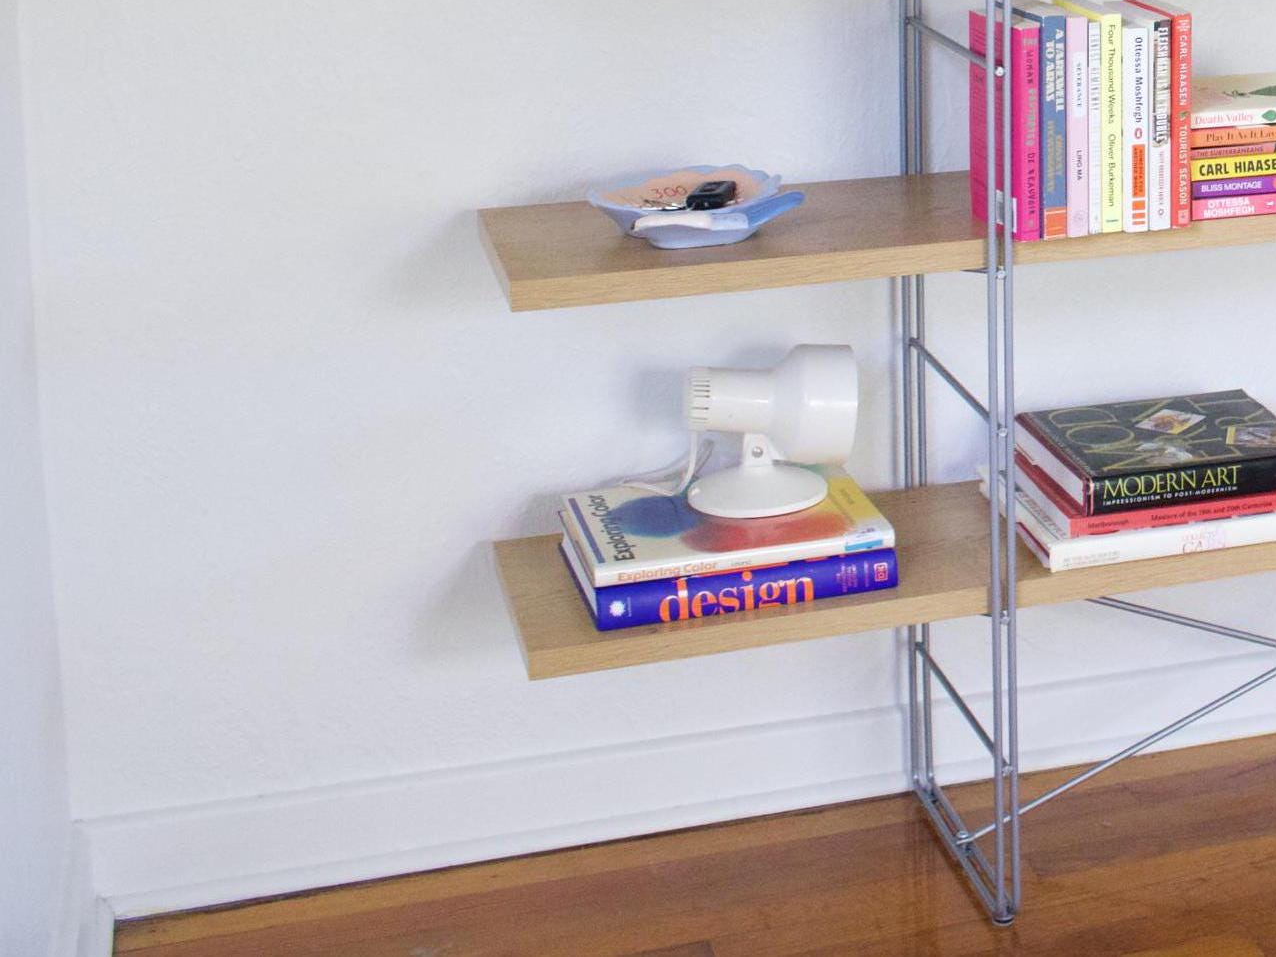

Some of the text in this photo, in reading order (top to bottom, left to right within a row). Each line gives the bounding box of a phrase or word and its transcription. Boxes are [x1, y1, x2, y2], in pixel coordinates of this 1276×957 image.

[1046, 40, 1055, 102] TO ARMS
[1055, 29, 1065, 113] A FAREWELL
[1108, 24, 1116, 124] Four Thousand Weeks
[1132, 37, 1144, 123] Ottessa Moshfegh
[1179, 35, 1188, 106] CARL HIAASEN
[1076, 169, 1083, 181] MA
[1108, 133, 1117, 207] Oliver Burkeman
[1179, 126, 1188, 205] TOURIST SEASON
[1199, 162, 1230, 176] CARL
[1201, 180, 1262, 192] BLISS MONTAGE
[1203, 206, 1255, 219] MOSHFEGH
[1207, 197, 1250, 209] OTTESSA
[1103, 465, 1242, 499] MODERN ART
[1103, 495, 1161, 506] IMPRESSIONISM
[600, 516, 637, 561] Exploring
[618, 560, 718, 583] Exploring Color
[659, 571, 815, 623] design
